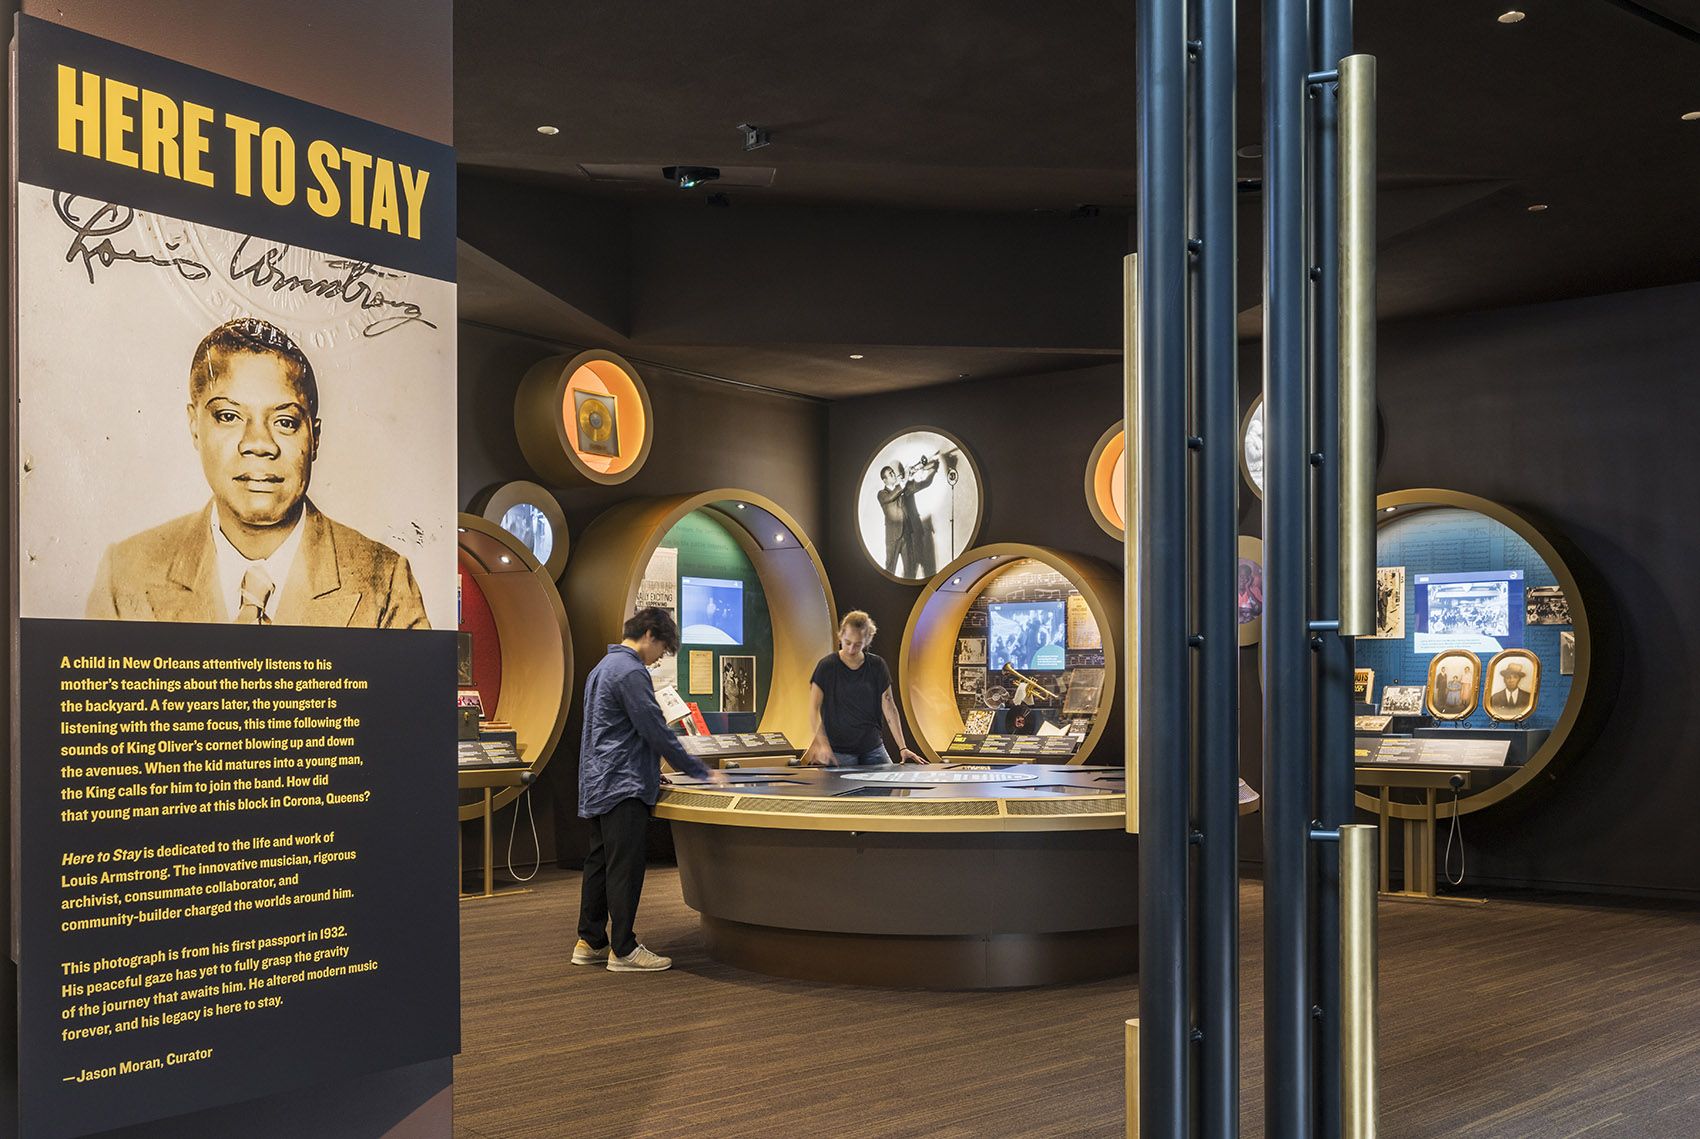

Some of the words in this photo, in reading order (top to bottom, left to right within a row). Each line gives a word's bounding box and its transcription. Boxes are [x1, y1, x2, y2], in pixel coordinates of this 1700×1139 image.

[58, 64, 214, 188] HERE
[225, 113, 296, 206] TO
[307, 140, 430, 240] STAY
[60, 656, 71, 669] A
[73, 656, 105, 669] child
[108, 656, 120, 669] in
[123, 656, 151, 669] New
[153, 657, 200, 669] Orleans
[202, 658, 264, 672] attentively
[265, 658, 302, 670] listens
[303, 660, 315, 670] to
[316, 659, 332, 670] his
[61, 678, 119, 690] mother’s
[120, 678, 181, 693] teachings
[183, 678, 218, 690] about
[219, 678, 239, 690] the
[240, 678, 273, 690] herbs
[274, 678, 294, 690] she
[295, 678, 342, 692] gathered
[343, 678, 368, 689] from
[60, 700, 83, 712] the
[85, 699, 148, 714] backyard.
[150, 699, 160, 711] A
[161, 699, 185, 711] few
[186, 701, 219, 713] years
[221, 698, 250, 711] later,
[252, 698, 271, 709] the
[272, 698, 326, 711] youngster
[327, 697, 337, 708] is
[61, 721, 118, 736] listening
[119, 720, 148, 733] with
[149, 720, 170, 732] the
[172, 722, 204, 731] same
[206, 719, 242, 731] focus,
[243, 718, 266, 730] this
[267, 717, 292, 729] time
[293, 716, 342, 730] following
[343, 716, 360, 727] the
[61, 742, 109, 756] sounds
[111, 742, 125, 754] of
[127, 741, 156, 756] King
[157, 739, 203, 753] Oliver’s
[205, 739, 243, 751] cornet
[245, 737, 289, 751] blowing
[290, 739, 304, 750] up
[305, 736, 325, 748] and
[327, 735, 354, 747] down
[60, 765, 83, 778] the
[85, 765, 142, 777] avenues.
[144, 761, 181, 774] When
[182, 760, 203, 772] the
[205, 759, 223, 771] kid
[225, 759, 272, 771] matures
[273, 757, 295, 768] into
[296, 758, 304, 767] a
[305, 756, 337, 769] young
[338, 756, 363, 766] man,
[60, 787, 83, 800] the
[86, 786, 116, 800] King
[118, 784, 148, 797] calls
[149, 783, 169, 795] for
[170, 782, 193, 794] him
[195, 782, 207, 792] to
[208, 779, 231, 794] join
[233, 778, 252, 790] the
[254, 776, 284, 789] band.
[286, 776, 311, 787] How
[312, 774, 329, 786] did
[61, 809, 89, 822] that
[91, 807, 131, 823] young
[132, 806, 159, 817] man
[161, 802, 197, 815] arrive
[199, 802, 212, 813] at
[213, 799, 236, 812] this
[238, 797, 268, 810] block
[270, 797, 281, 808] in
[283, 795, 324, 807] Corona,
[326, 790, 371, 804] Queens?
[61, 852, 95, 866] Here
[97, 851, 111, 863] to
[112, 848, 143, 862] Stay
[143, 847, 154, 859] is
[156, 841, 215, 857] dedicated
[217, 842, 230, 852] to
[231, 839, 251, 851] the
[252, 837, 271, 849] life
[272, 834, 293, 847] and
[294, 832, 322, 845] work
[323, 831, 335, 843] of
[61, 873, 98, 888] Louis
[100, 868, 171, 884] Armstrong.
[173, 864, 196, 877] The
[198, 859, 258, 874] innovative
[260, 854, 312, 868] musician,
[313, 851, 356, 865] rigorous
[61, 893, 122, 910] archivist,
[124, 885, 203, 903] consummate
[205, 878, 276, 894] collaborator,
[278, 873, 299, 886] and
[61, 907, 182, 932] community-builder
[184, 900, 232, 917] charged
[233, 899, 253, 911] the
[254, 894, 292, 909] worlds
[293, 889, 331, 904] around
[332, 888, 354, 899] him.
[61, 961, 90, 975] This
[93, 950, 166, 974] photograph
[168, 949, 179, 961] is
[181, 947, 210, 959] from
[212, 942, 230, 955] his
[231, 939, 256, 952] first
[258, 932, 306, 951] passport
[308, 930, 318, 941] in
[320, 925, 348, 939] 1932.
[62, 984, 84, 998] His
[87, 974, 142, 996] peaceful
[145, 972, 173, 987] gaze
[176, 969, 197, 980] has
[199, 964, 218, 980] yet
[220, 963, 232, 974] to
[234, 958, 260, 972] fully
[261, 955, 292, 970] grasp
[294, 951, 312, 963] the
[313, 945, 349, 962] gravity
[62, 1005, 76, 1019] of
[78, 1004, 100, 1016] the
[101, 997, 151, 1016] journey
[153, 991, 178, 1005] that
[180, 985, 220, 1000] awaits
[222, 981, 246, 994] him.
[249, 977, 264, 990] He
[266, 970, 305, 987] altered
[307, 966, 346, 980] modern
[348, 960, 378, 974] music
[62, 1024, 112, 1041] forever,
[115, 1017, 138, 1032] and
[141, 1015, 160, 1028] his
[162, 1009, 201, 1025] legacy
[203, 1006, 213, 1017] is
[216, 1003, 242, 1015] here
[244, 1000, 256, 1010] to
[258, 996, 283, 1008] stay.
[120, 1058, 164, 1074] Moran,
[166, 1048, 213, 1065] Curator
